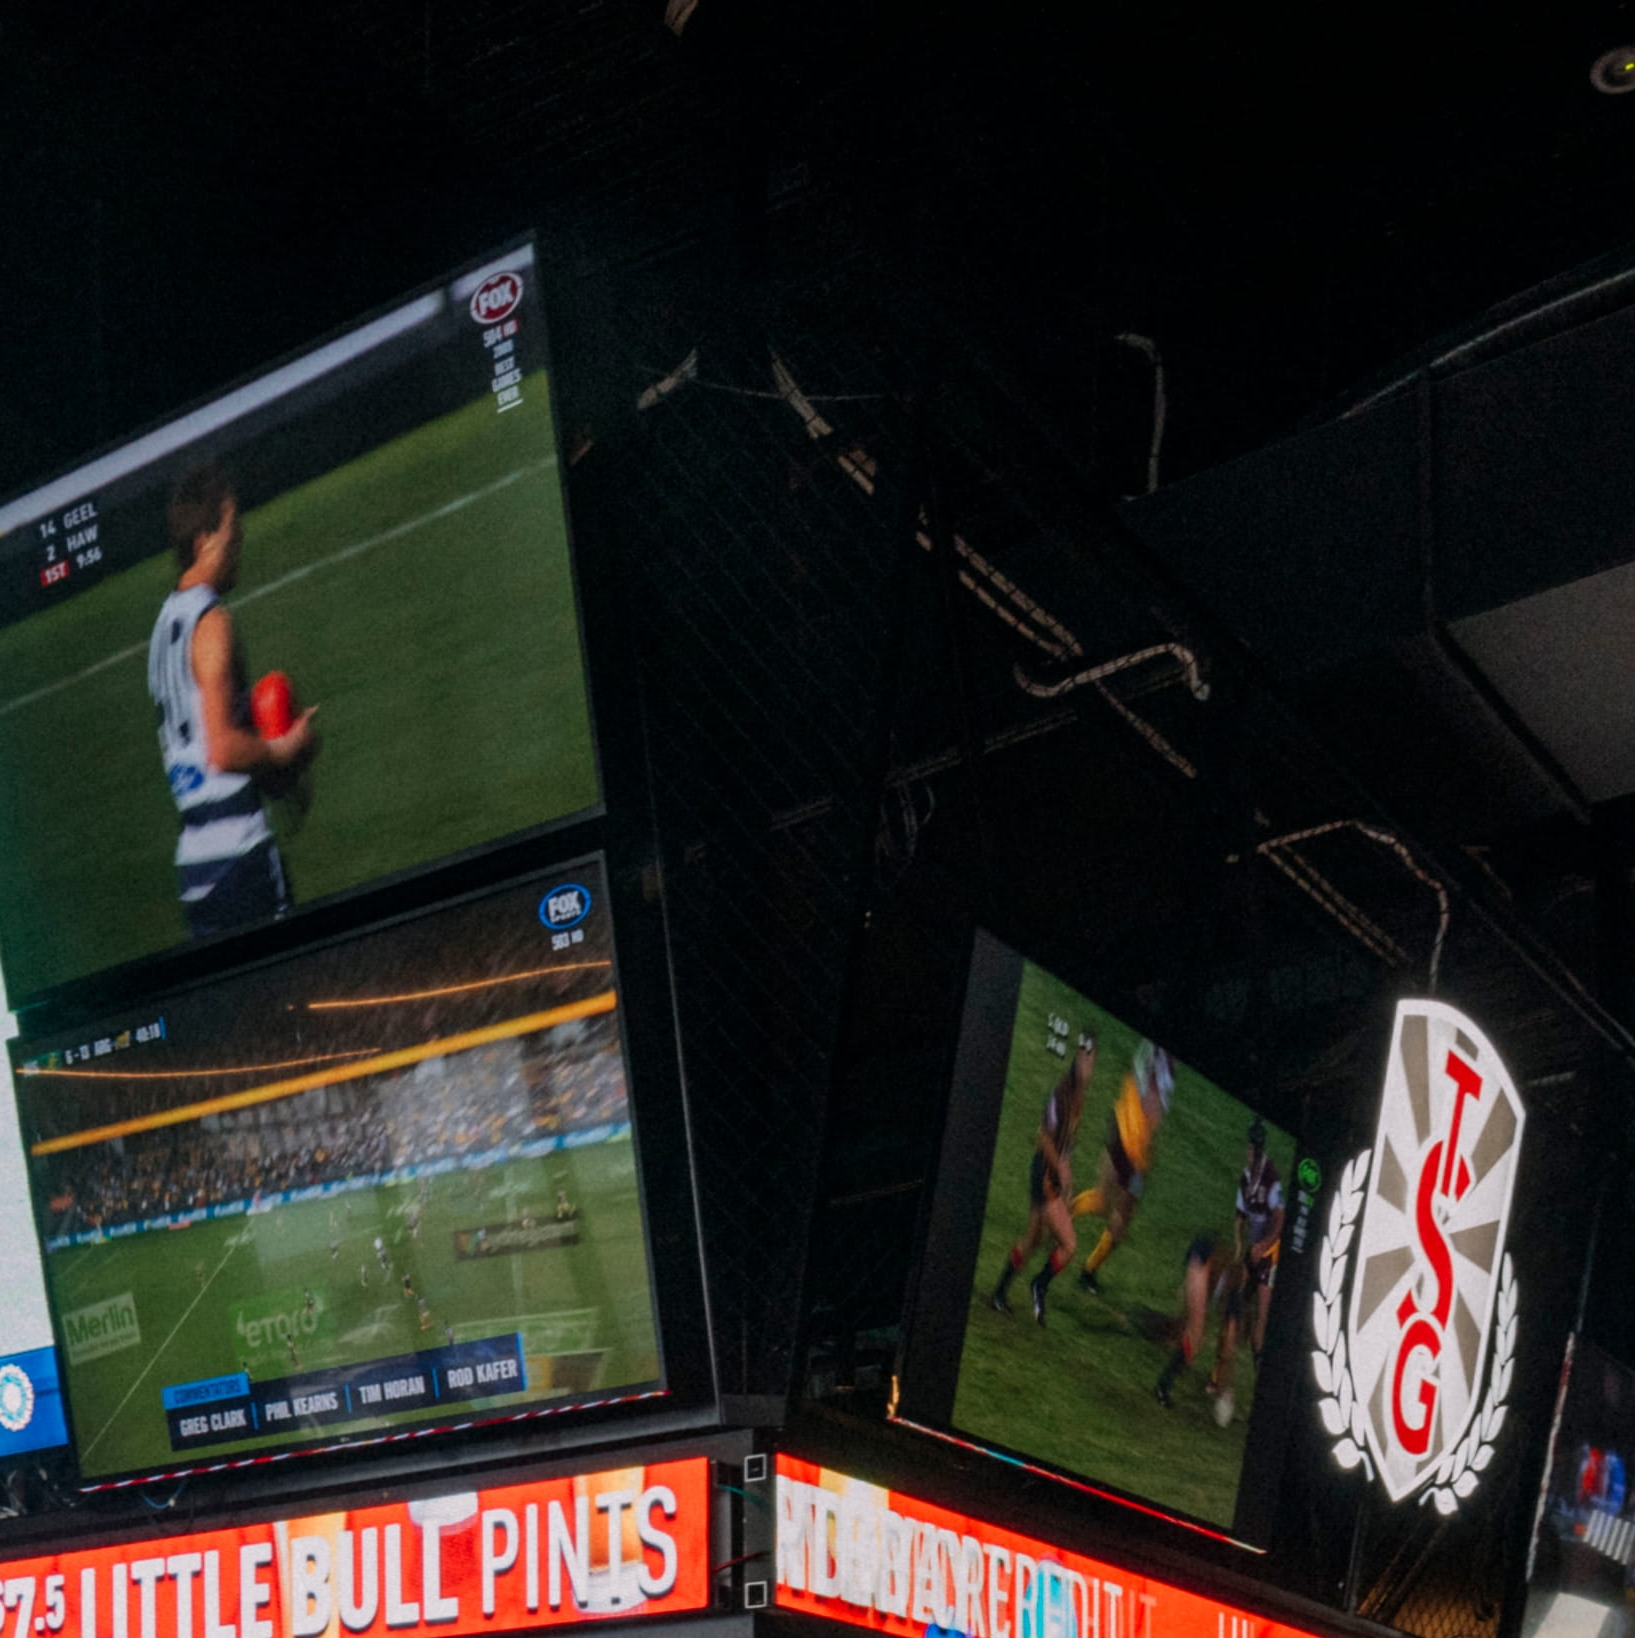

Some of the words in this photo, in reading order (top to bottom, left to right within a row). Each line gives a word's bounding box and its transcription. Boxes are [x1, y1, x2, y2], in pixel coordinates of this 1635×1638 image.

[478, 281, 513, 316] FOX
[40, 520, 56, 538] 14
[64, 502, 98, 528] GEEL
[46, 544, 56, 561] 2
[67, 524, 98, 552] HAW
[45, 562, 67, 584] 1ST
[76, 546, 102, 569] 9:56
[548, 891, 581, 922] FOX
[66, 1302, 133, 1346] Merlin
[360, 1383, 383, 1404] TIM
[385, 1376, 425, 1400] HORAN
[447, 1367, 473, 1389] ROD
[476, 1359, 518, 1383] KAFER
[180, 1415, 209, 1437] GREG
[210, 1409, 246, 1431] CLARK
[265, 1401, 292, 1421] PHIL
[293, 1392, 338, 1416] KEARNS
[291, 1520, 459, 1638] BULL
[482, 1485, 677, 1616] PINTS
